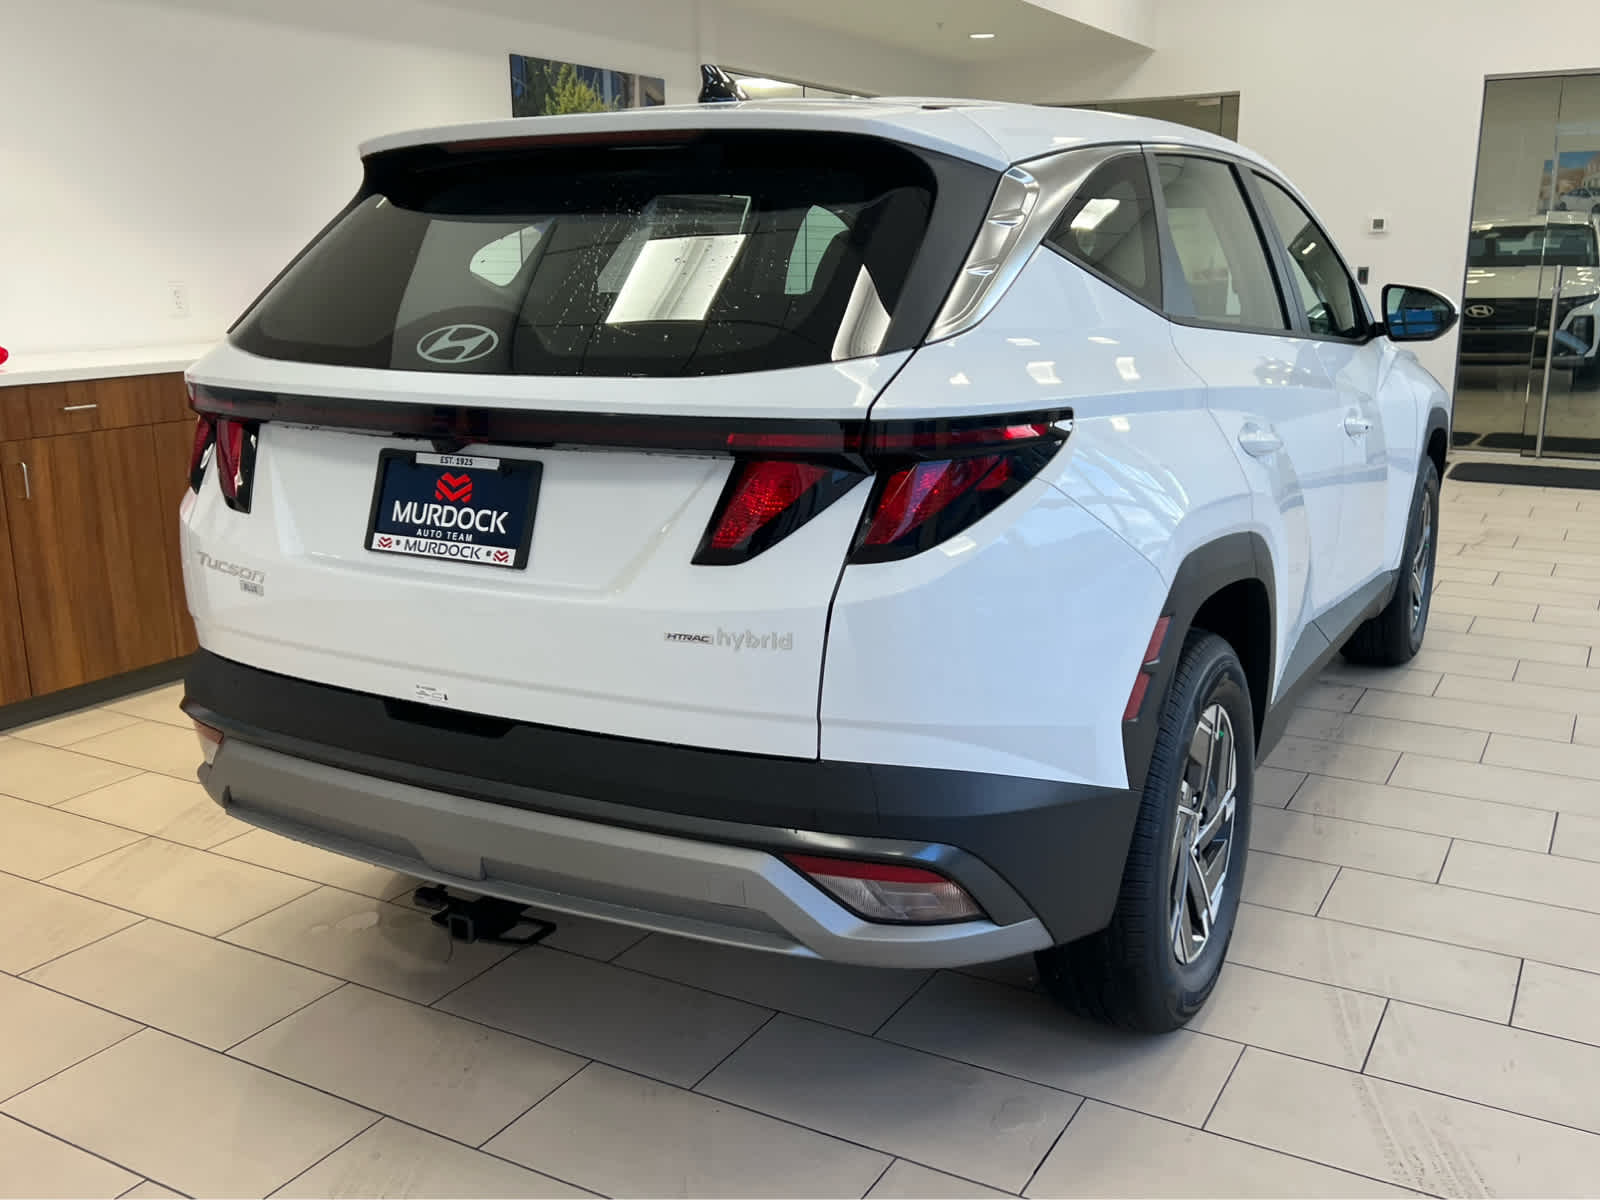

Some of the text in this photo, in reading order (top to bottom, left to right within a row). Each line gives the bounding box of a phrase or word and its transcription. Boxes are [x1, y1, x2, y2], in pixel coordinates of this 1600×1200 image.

[440, 456, 473, 466] EST. 1925
[392, 500, 508, 534] MURDOCK
[416, 528, 473, 542] AUTO TEAM
[404, 539, 482, 560] MURDOCK
[667, 627, 793, 651] HTRAC hybrid
